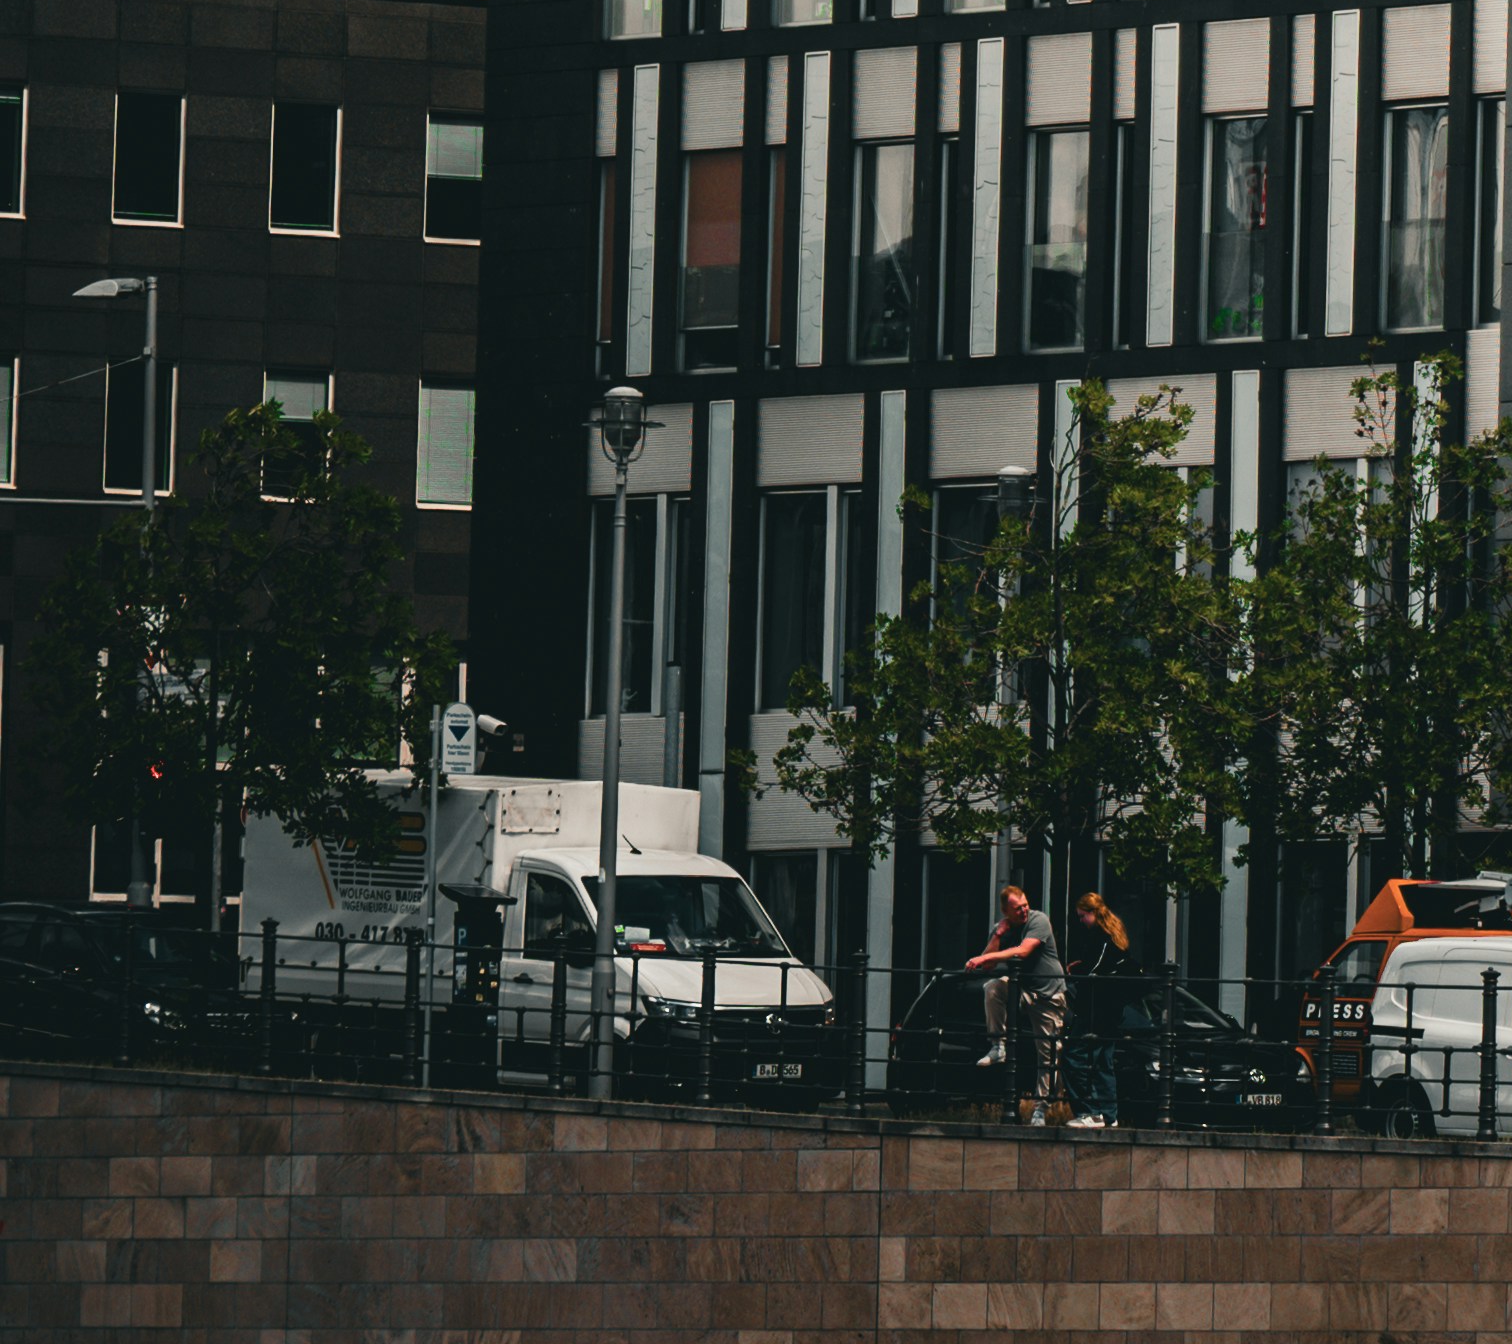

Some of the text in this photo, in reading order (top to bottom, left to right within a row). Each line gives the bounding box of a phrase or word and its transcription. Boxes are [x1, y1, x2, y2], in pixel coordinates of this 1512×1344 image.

[339, 887, 392, 902] WOLFGANG
[342, 900, 398, 913] INGENIEURBAU
[315, 922, 344, 940] 030
[361, 925, 389, 942] 417
[1306, 1003, 1364, 1019] PESS
